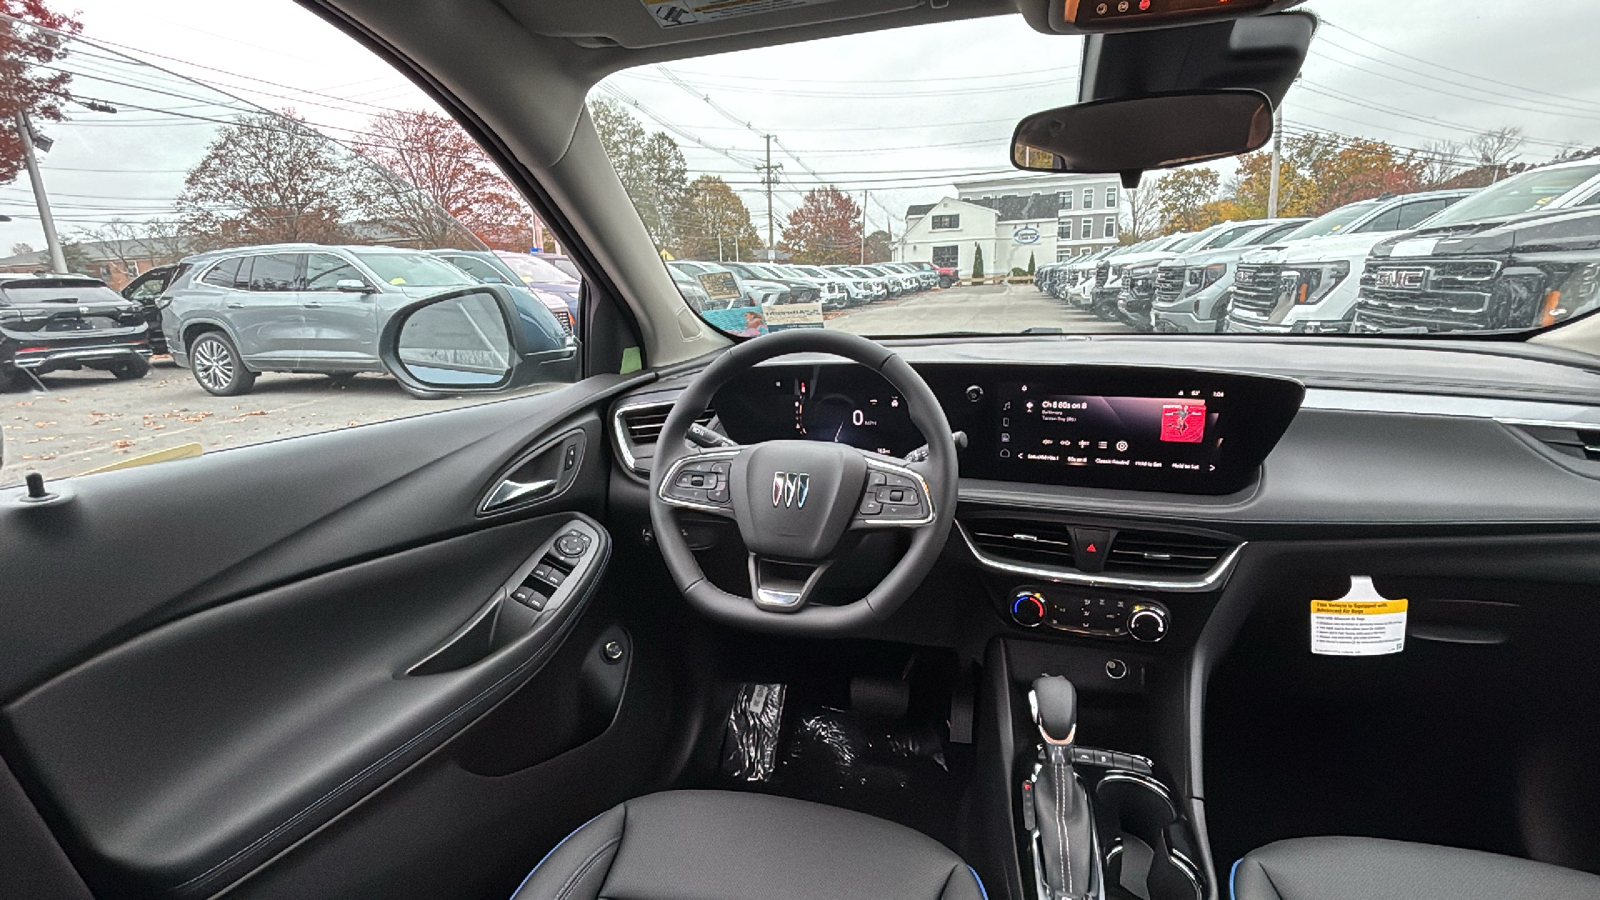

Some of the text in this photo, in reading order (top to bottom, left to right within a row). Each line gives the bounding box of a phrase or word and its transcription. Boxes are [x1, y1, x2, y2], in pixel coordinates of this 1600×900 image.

[1375, 271, 1423, 288] GMC
[1082, 402, 1087, 410] 8
[853, 410, 864, 426] 0
